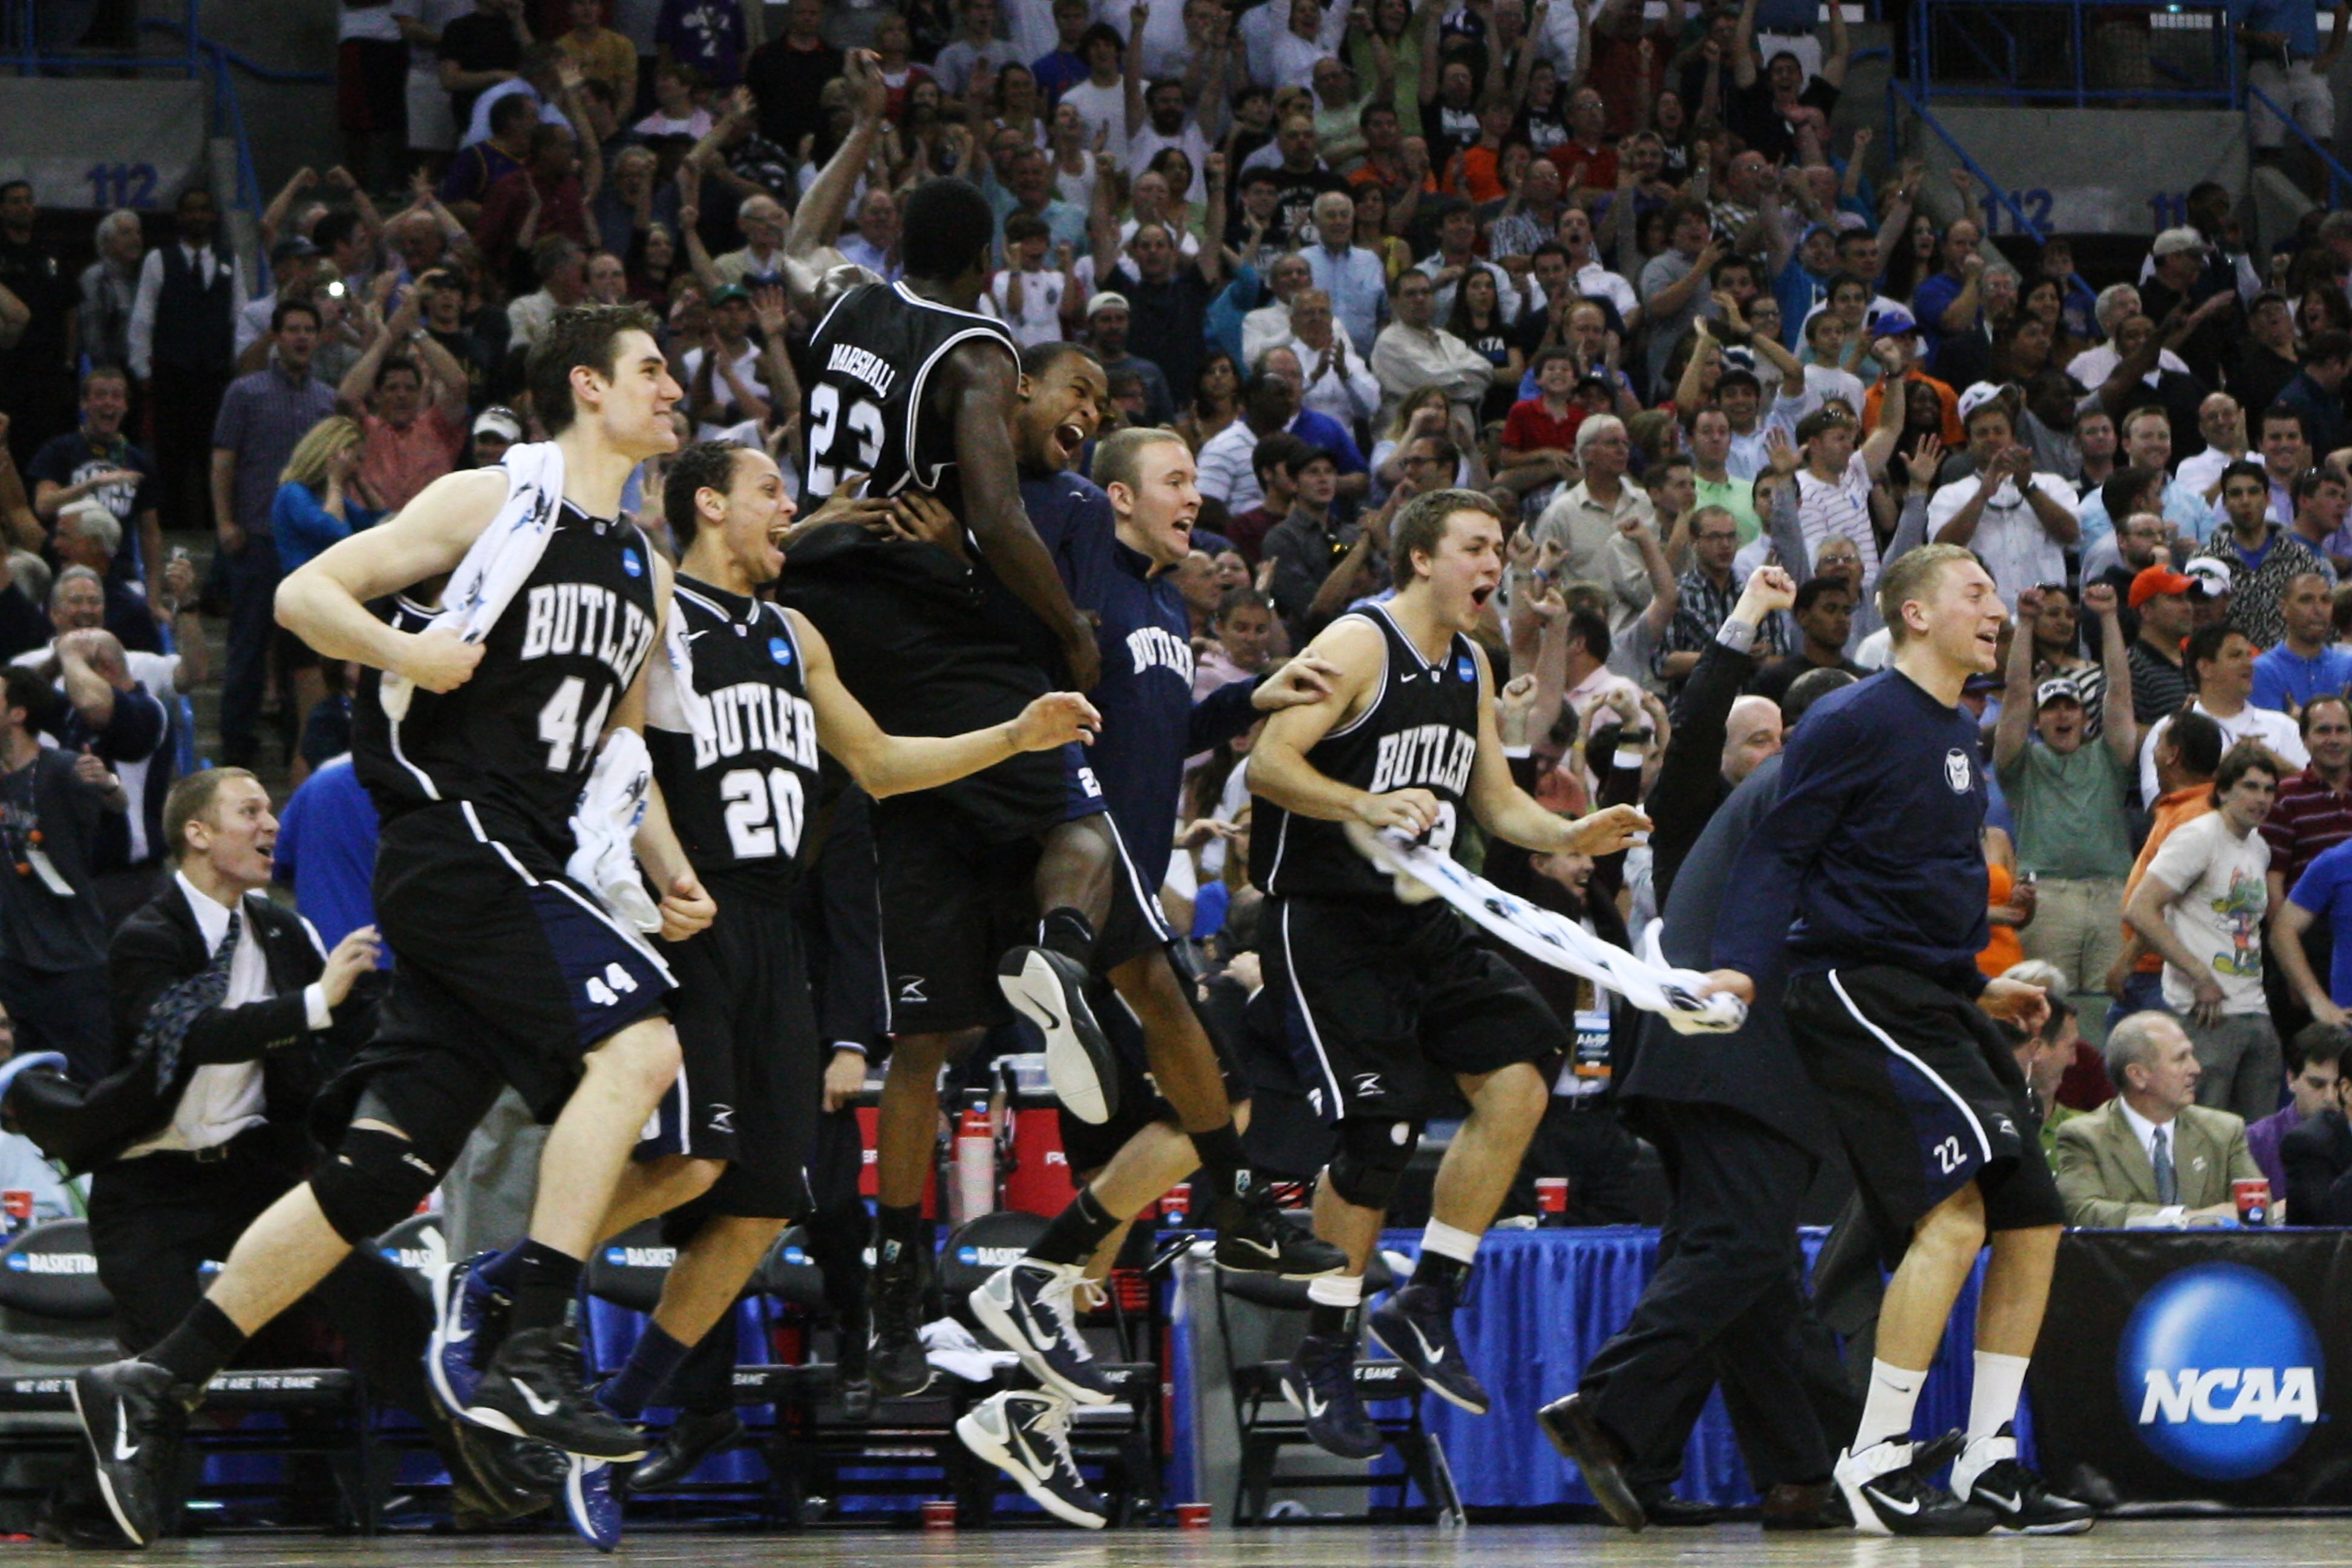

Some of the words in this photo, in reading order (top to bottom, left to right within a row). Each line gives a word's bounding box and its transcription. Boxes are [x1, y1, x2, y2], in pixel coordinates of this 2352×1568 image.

[87, 163, 158, 207] 112
[1980, 188, 2054, 234] 112
[2146, 190, 2186, 234] 11
[827, 343, 895, 398] MARSHALL
[808, 382, 886, 497] 23
[521, 583, 656, 691] BUTLER
[1126, 626, 1194, 690] BUTLER
[693, 682, 819, 773] BUTLER
[1077, 766, 1102, 798] 2
[1368, 724, 1477, 797] BUTLER
[720, 767, 804, 860] 20
[586, 962, 638, 1005] 44
[1933, 1135, 1967, 1174] 22
[2138, 1367, 2319, 1424] NCAA
